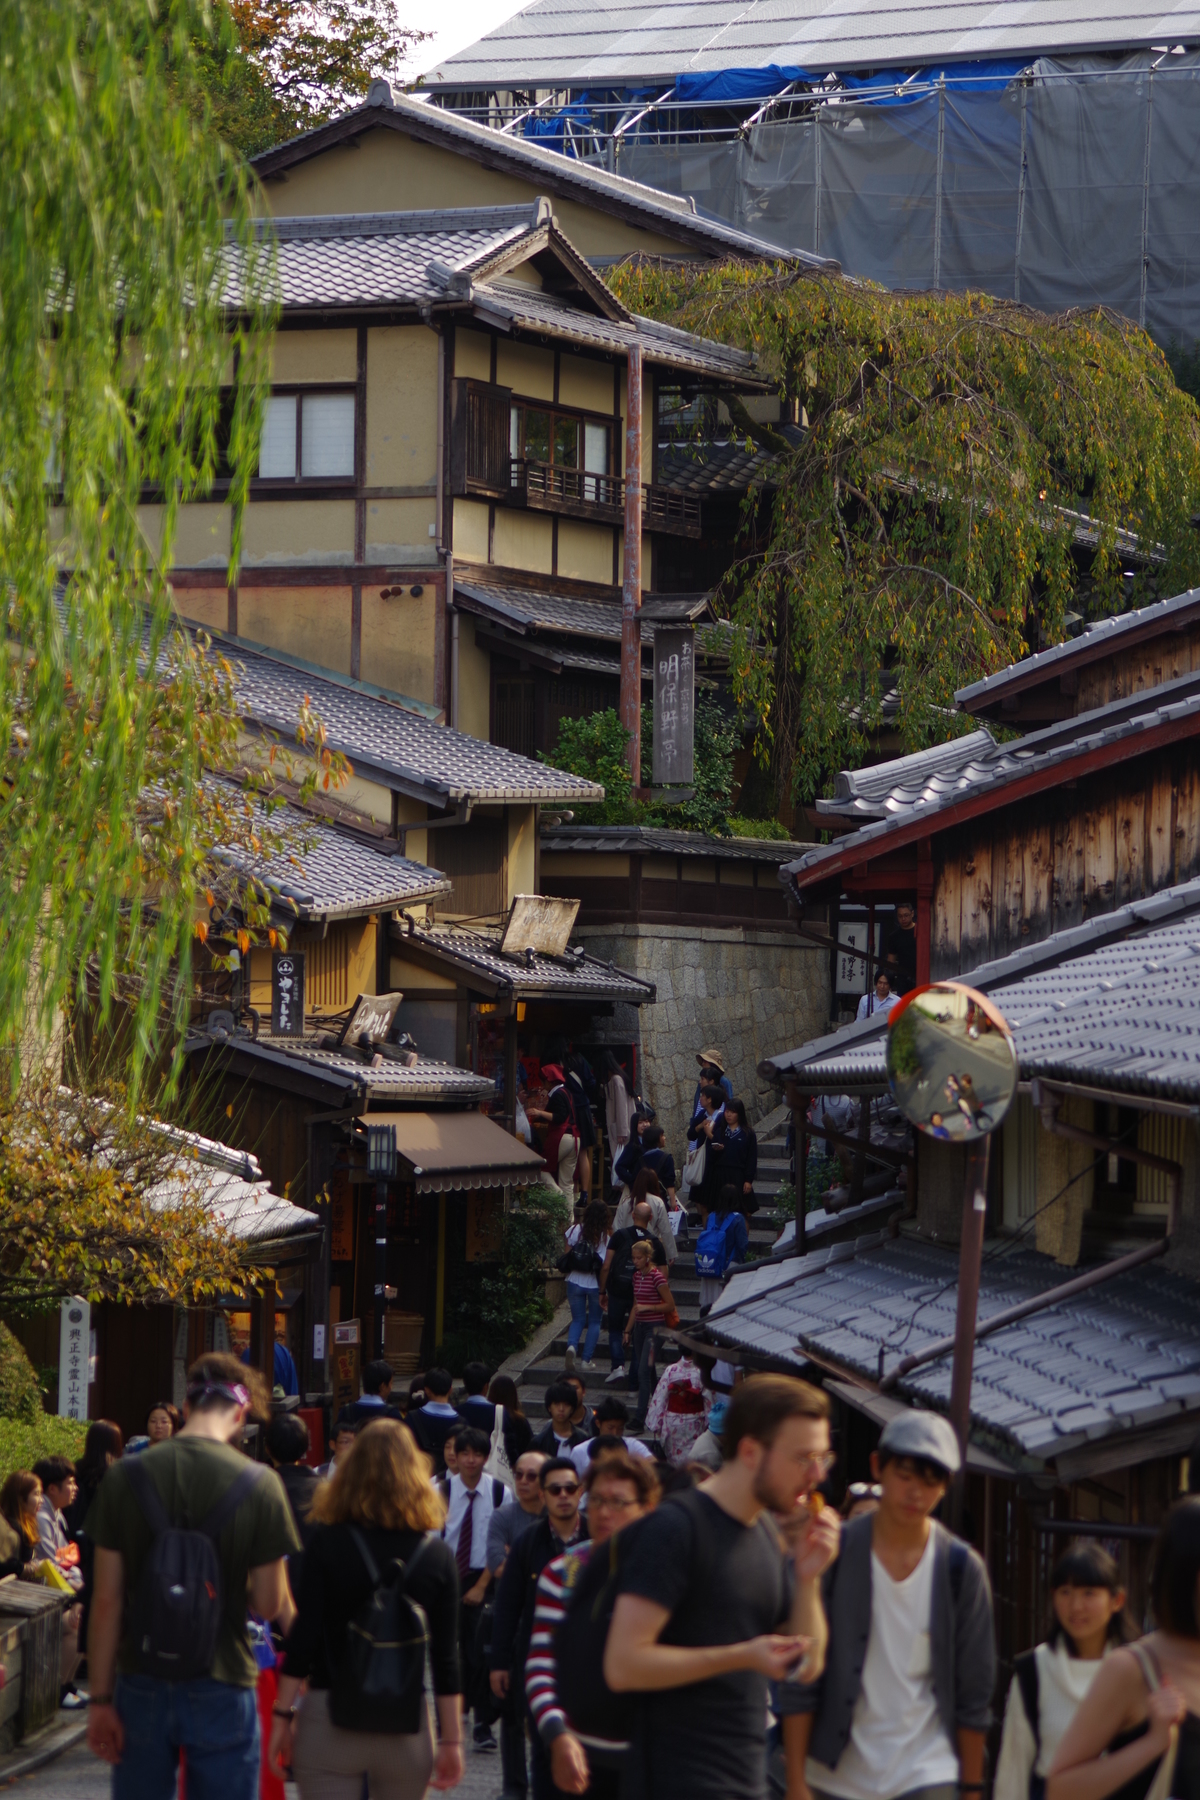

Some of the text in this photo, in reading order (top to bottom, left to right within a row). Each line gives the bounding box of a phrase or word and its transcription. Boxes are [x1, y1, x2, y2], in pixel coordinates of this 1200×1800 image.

[659, 653, 679, 764] 明保野亭
[847, 935, 857, 982] 明野亭
